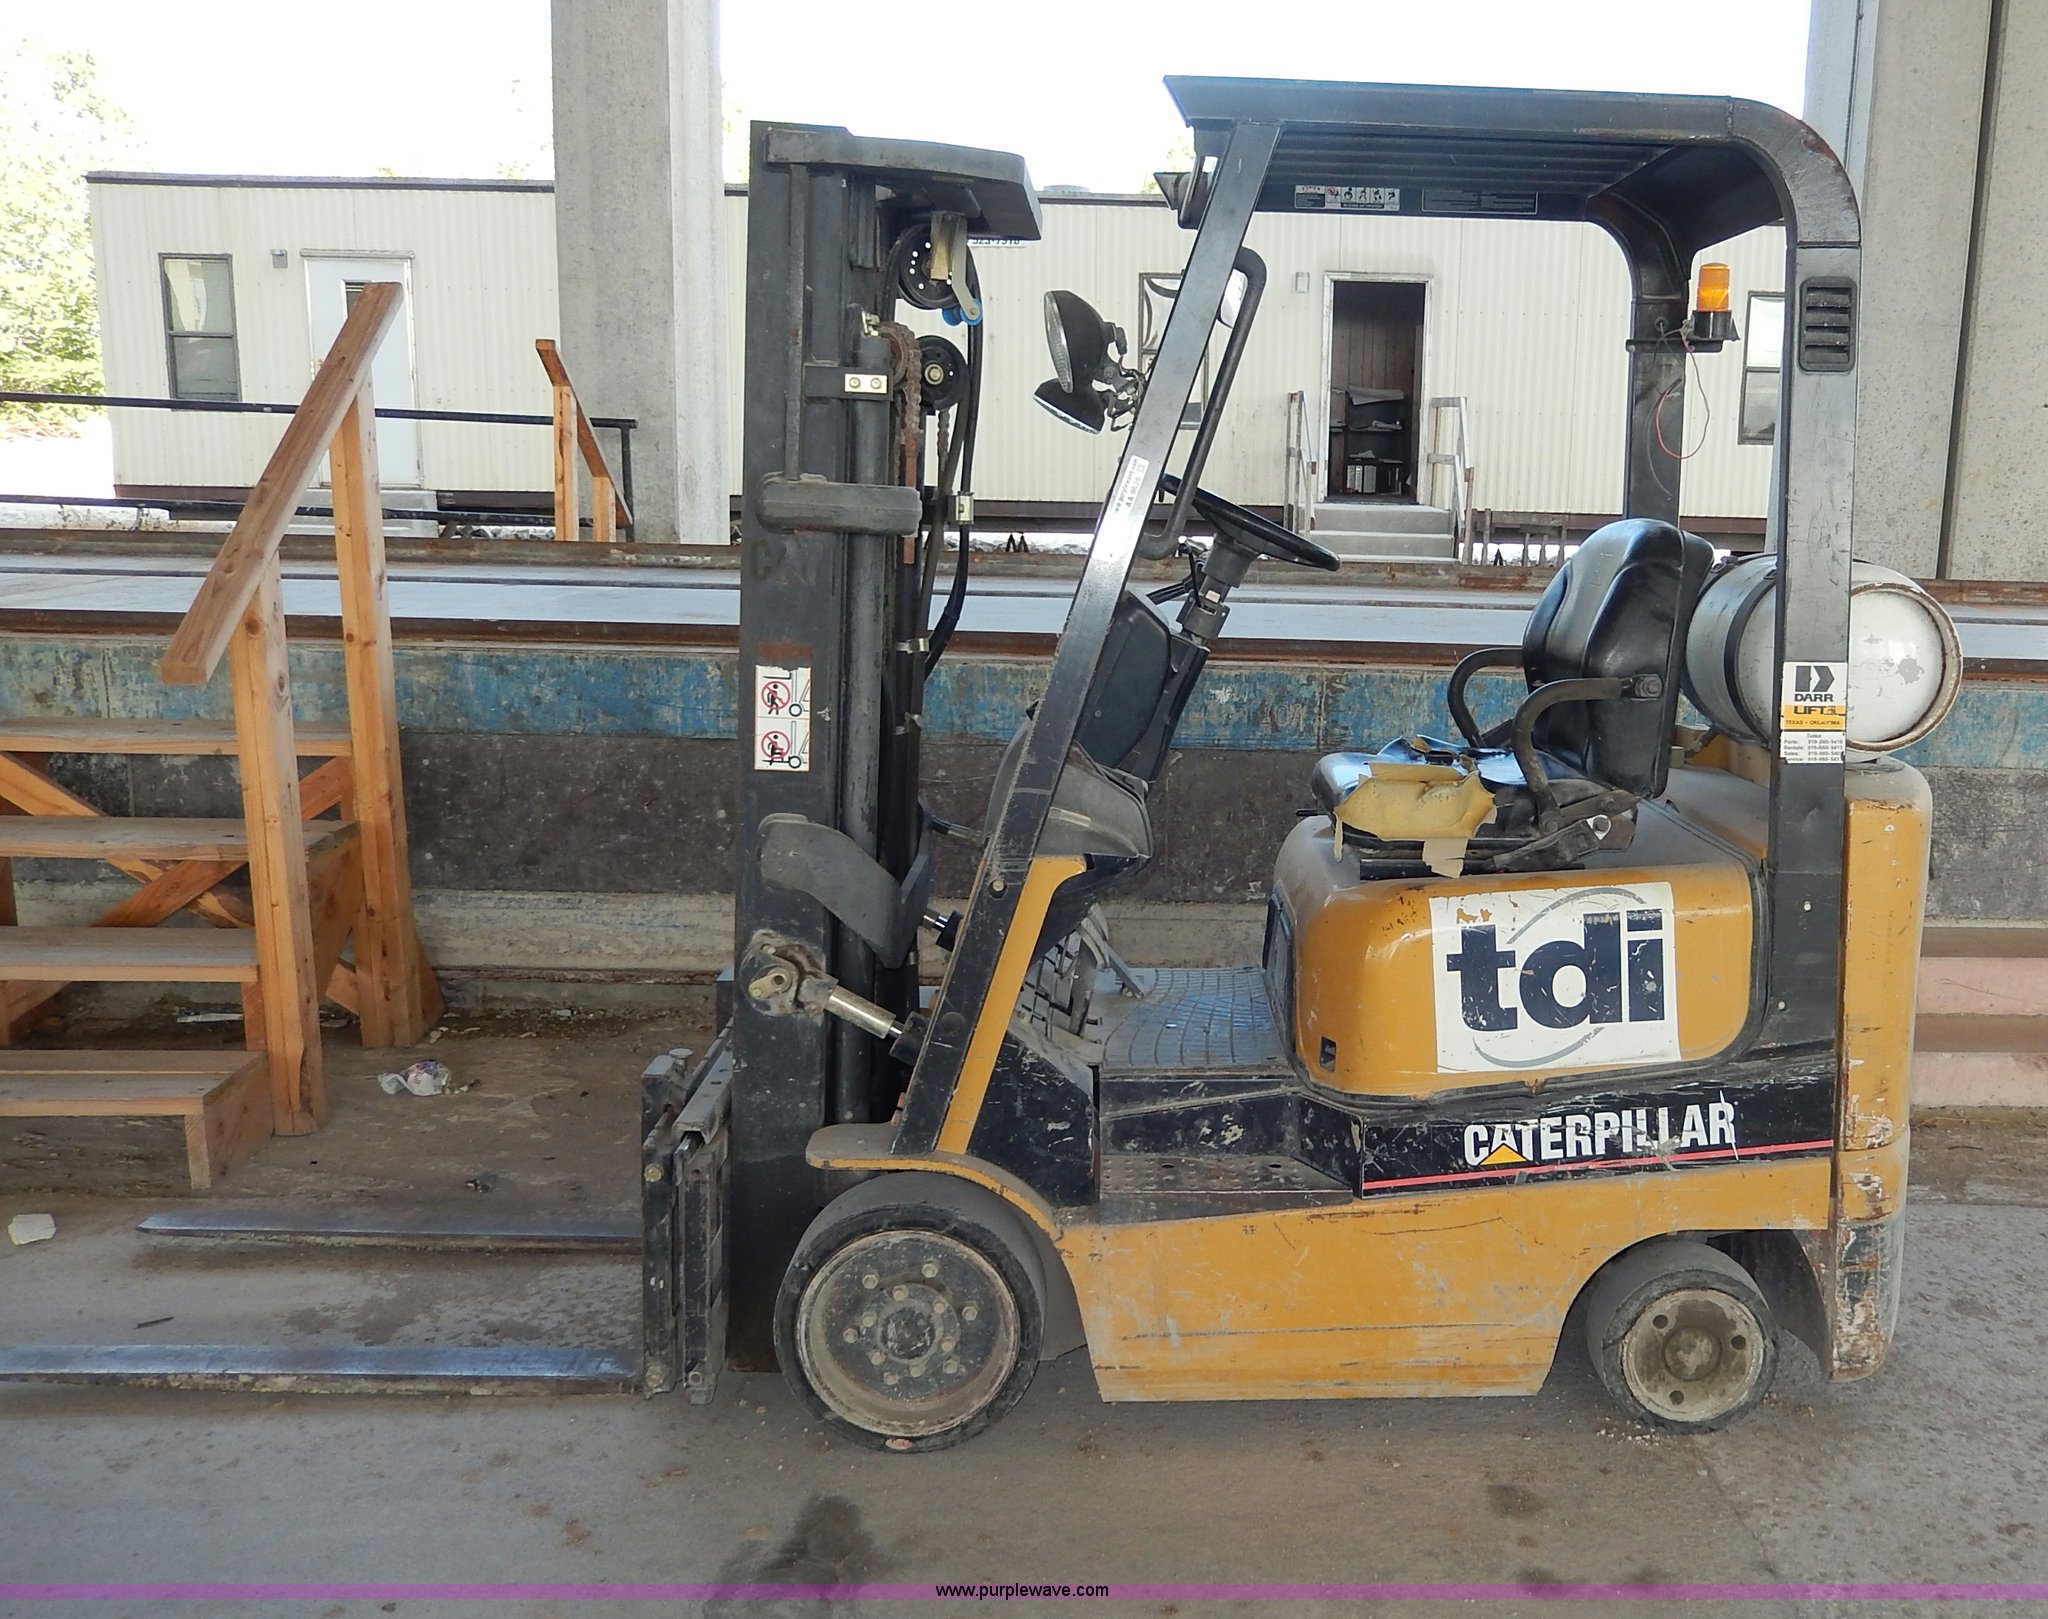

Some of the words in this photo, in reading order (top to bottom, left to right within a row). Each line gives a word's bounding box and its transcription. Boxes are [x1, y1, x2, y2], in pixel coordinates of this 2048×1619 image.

[1795, 694, 1834, 702] DARR
[1446, 908, 1665, 1032] tdi
[1463, 1101, 1738, 1166] CATERPILLAR
